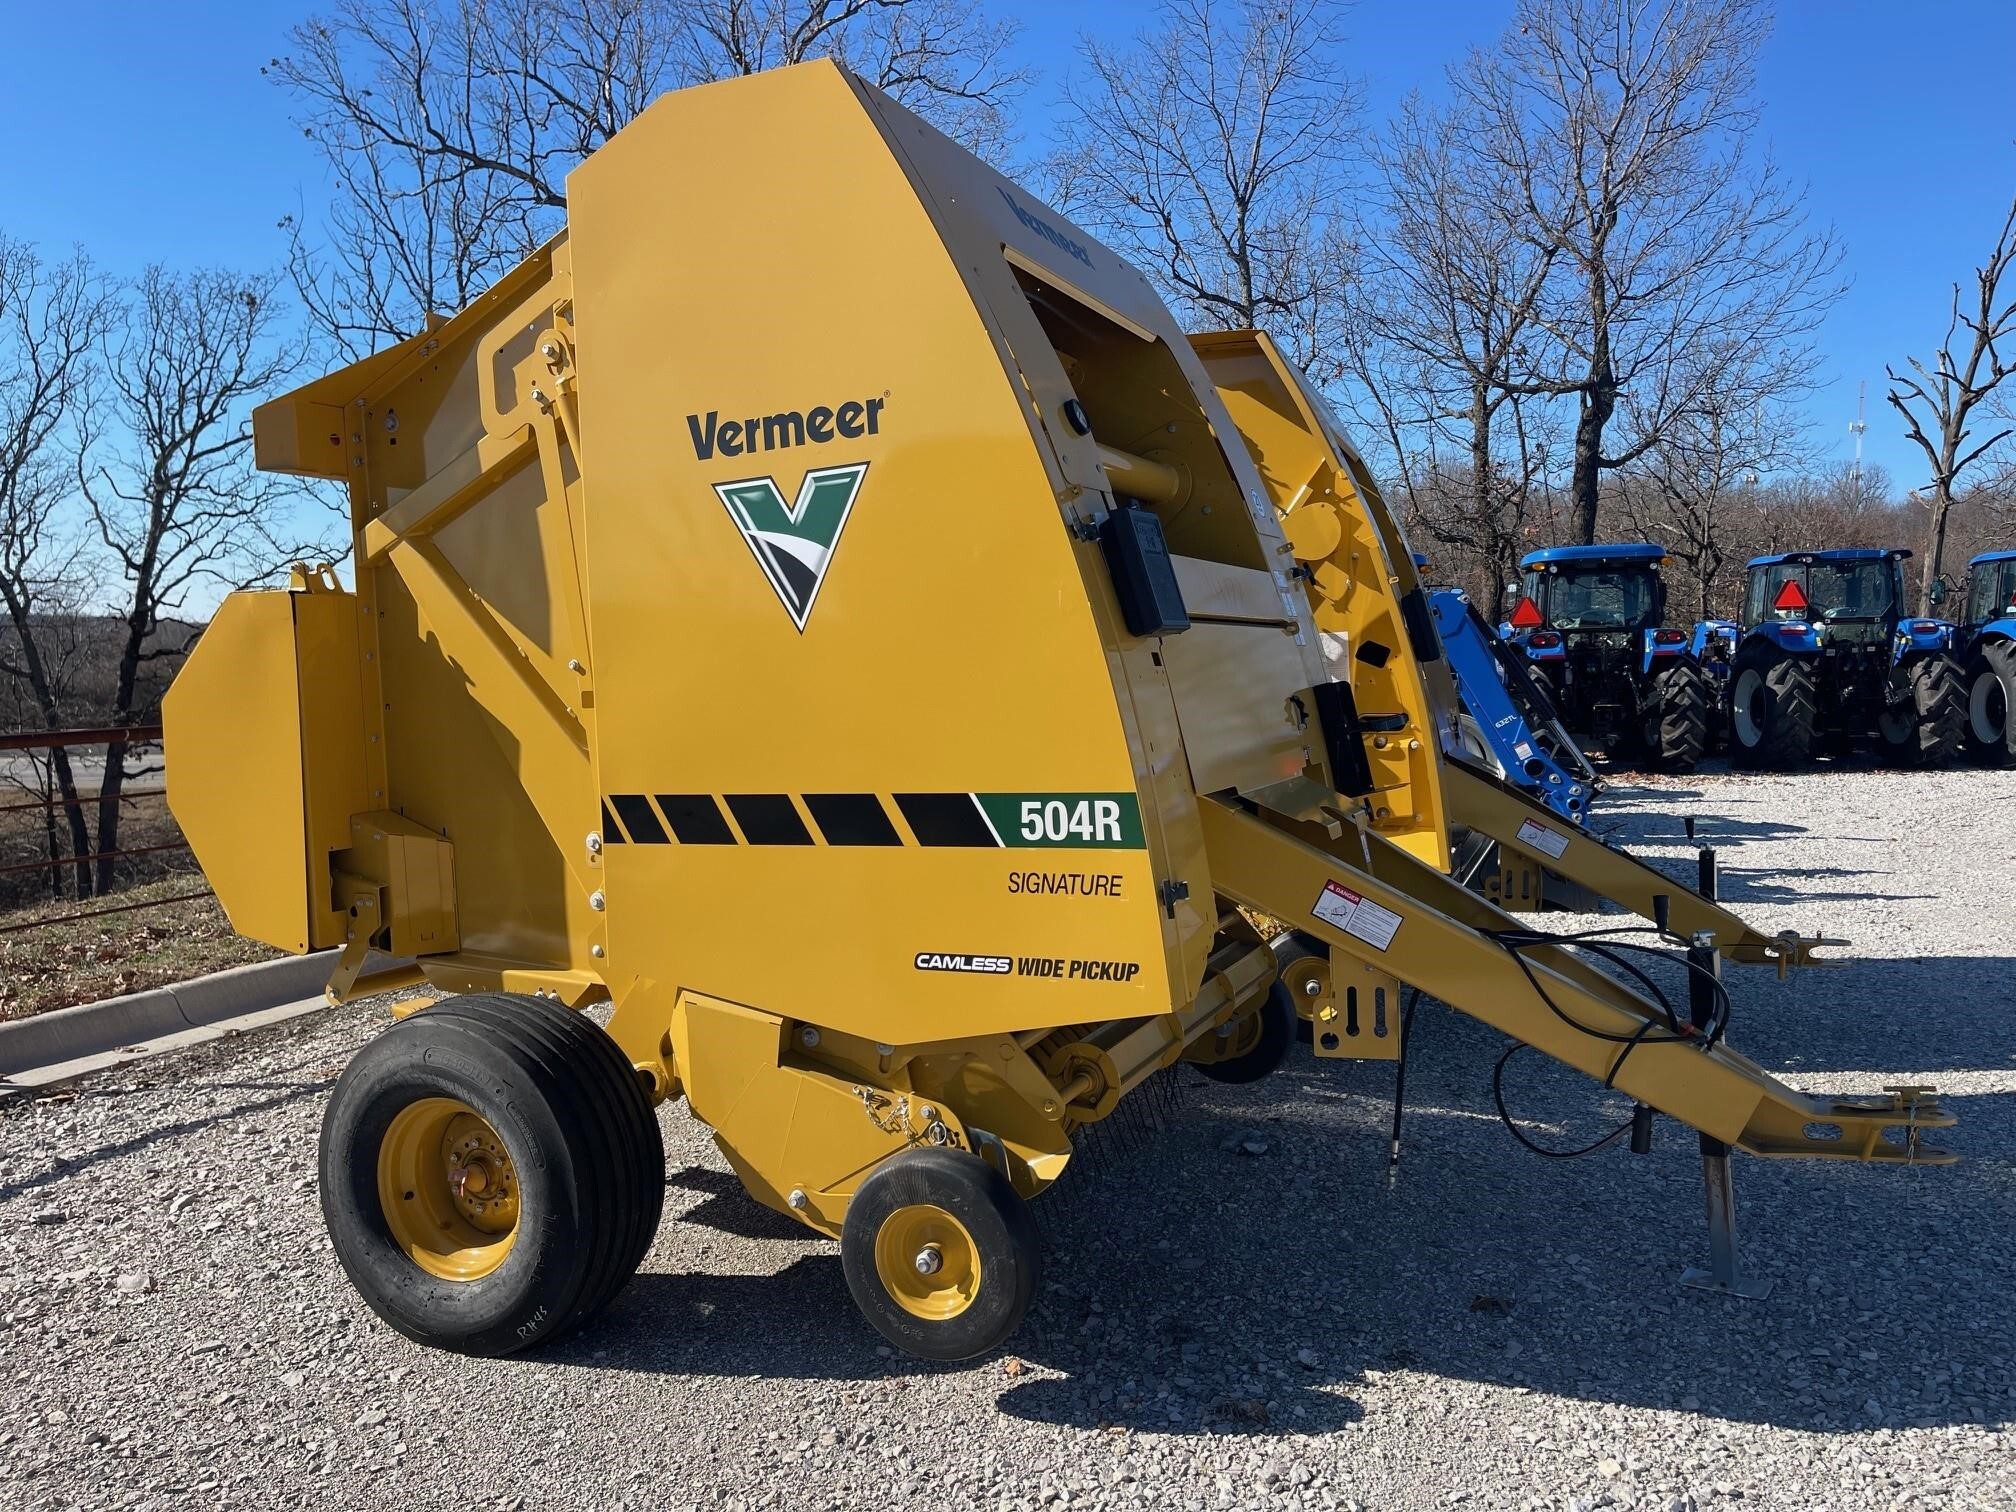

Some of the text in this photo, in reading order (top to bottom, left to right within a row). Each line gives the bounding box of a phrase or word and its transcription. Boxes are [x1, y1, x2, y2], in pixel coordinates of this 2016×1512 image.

[995, 185, 1096, 272] Vermeer
[686, 397, 885, 461] Vermeer
[1495, 714, 1518, 729] 632TL
[1020, 800, 1122, 841] 504R
[1007, 871, 1124, 897] SIGNATURE
[1334, 886, 1361, 903] DANGER
[916, 954, 1140, 982] CAMLESS WIDE PICKUP
